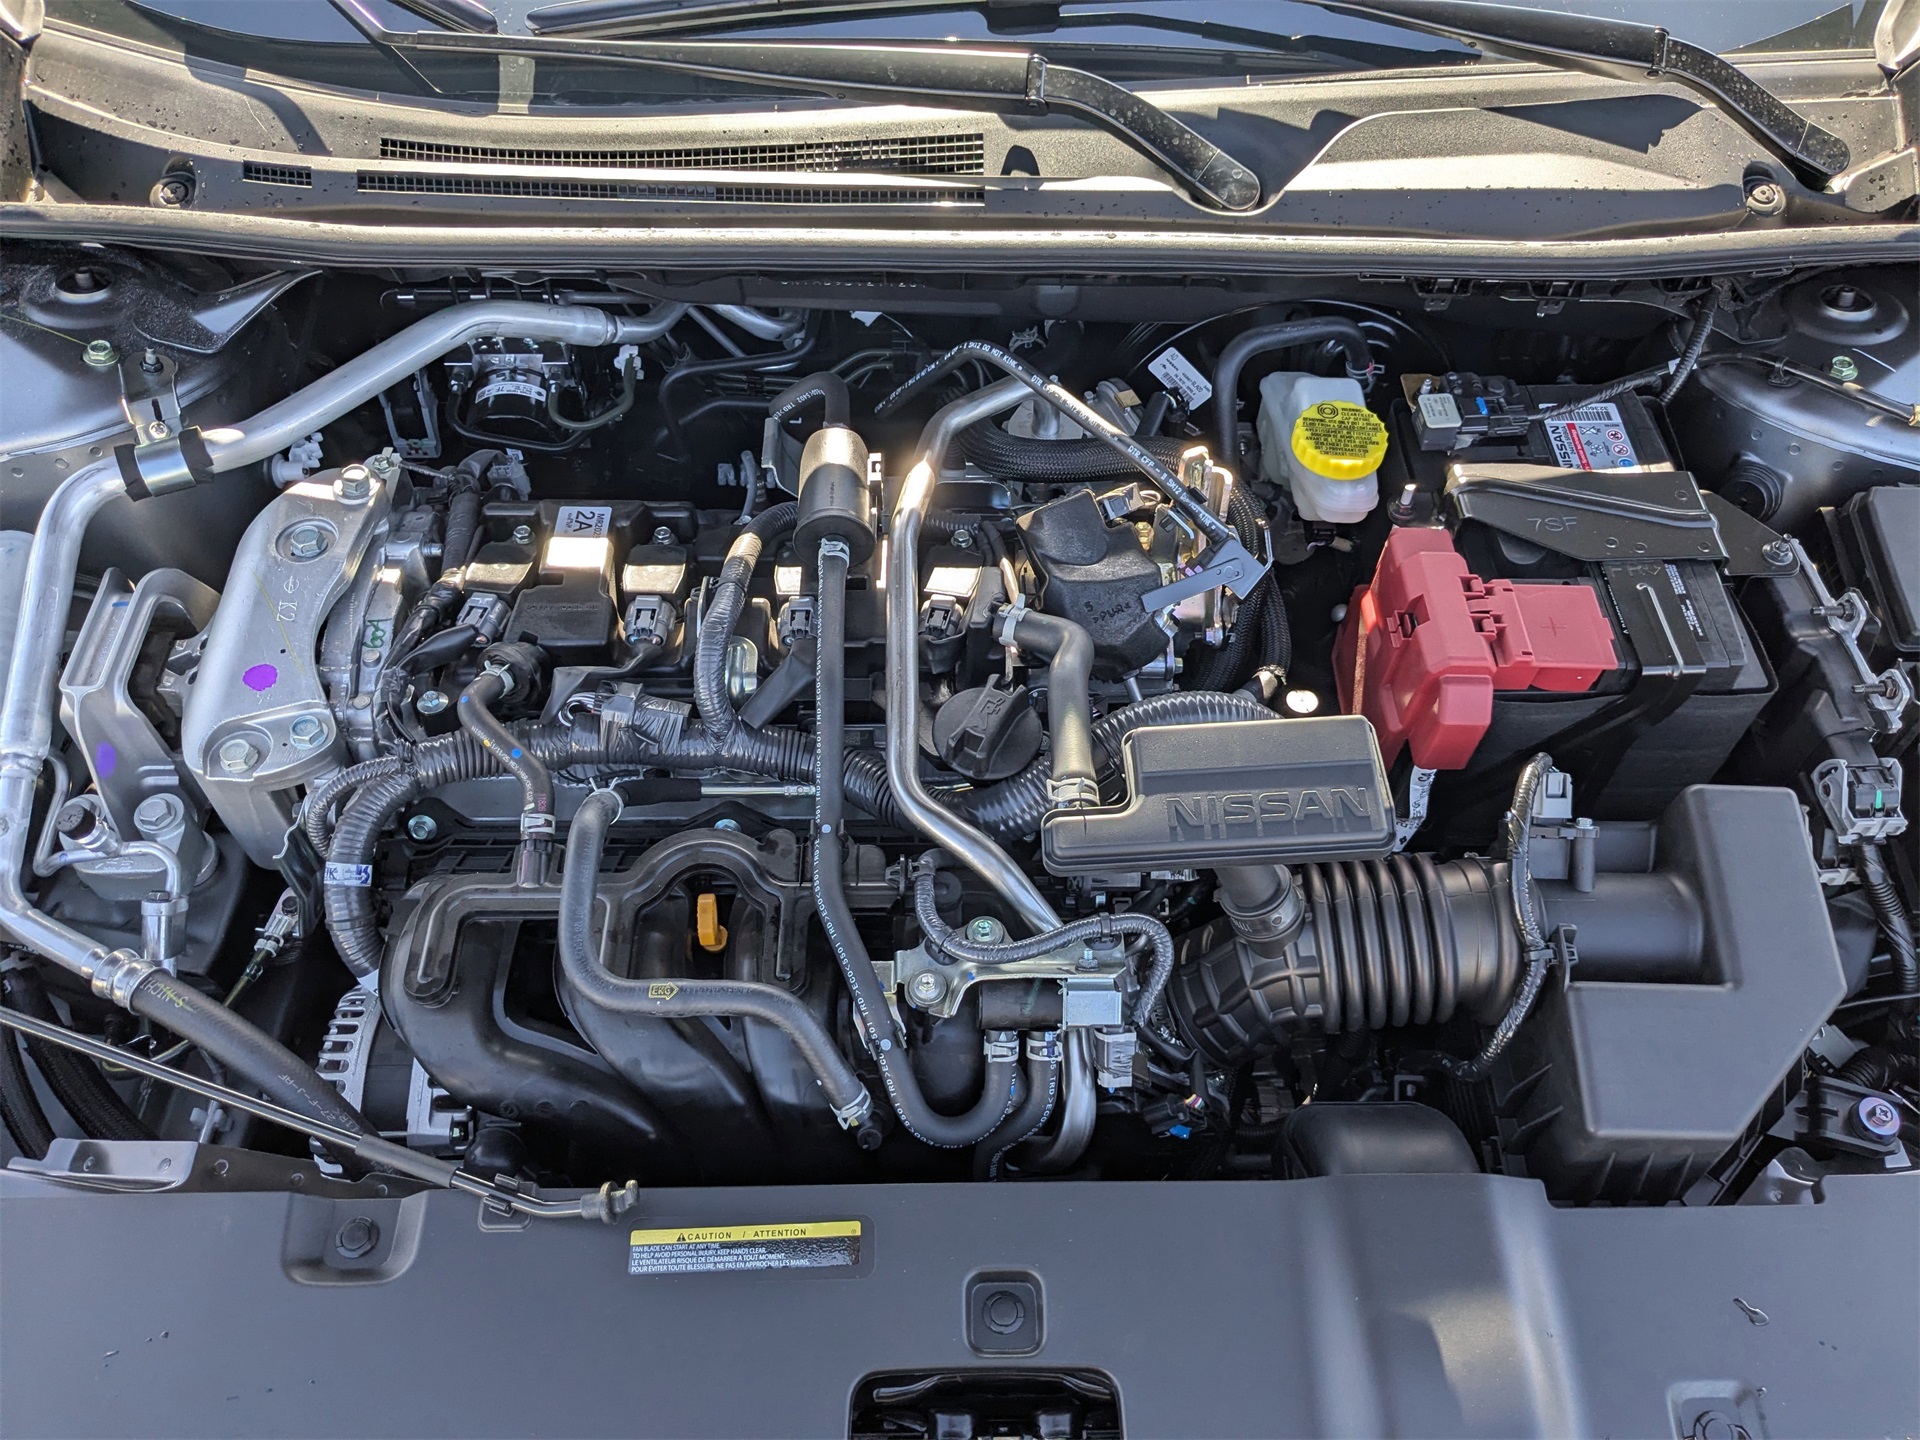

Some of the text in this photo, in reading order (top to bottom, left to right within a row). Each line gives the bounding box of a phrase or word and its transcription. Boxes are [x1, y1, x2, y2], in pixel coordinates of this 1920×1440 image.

[573, 510, 596, 532] 2A
[1527, 516, 1578, 532] 7SF
[1164, 788, 1370, 828] NISSAN
[834, 942, 870, 1017] TRD>ECO<5501
[688, 1232, 732, 1240] CAUTION
[754, 1228, 807, 1238] ATTENTION
[745, 1260, 780, 1268] APPROCHER
